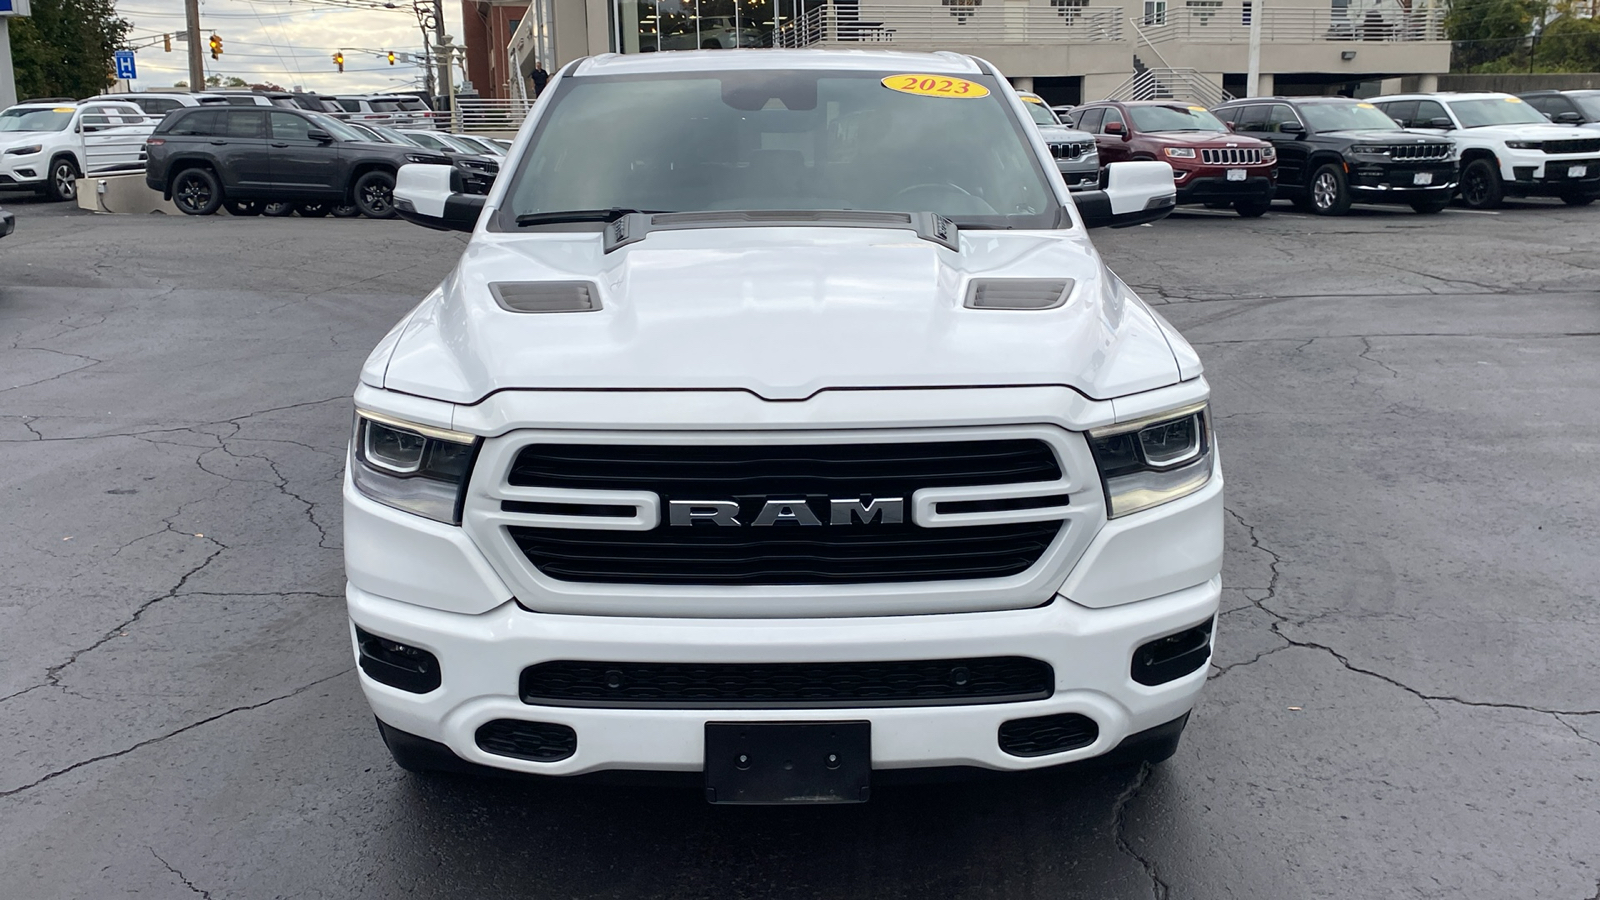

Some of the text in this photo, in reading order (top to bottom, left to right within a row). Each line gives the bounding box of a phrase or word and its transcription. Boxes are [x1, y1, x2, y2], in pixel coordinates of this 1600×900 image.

[120, 57, 132, 71] H
[901, 77, 971, 94] 2023
[669, 497, 904, 526] RAM
